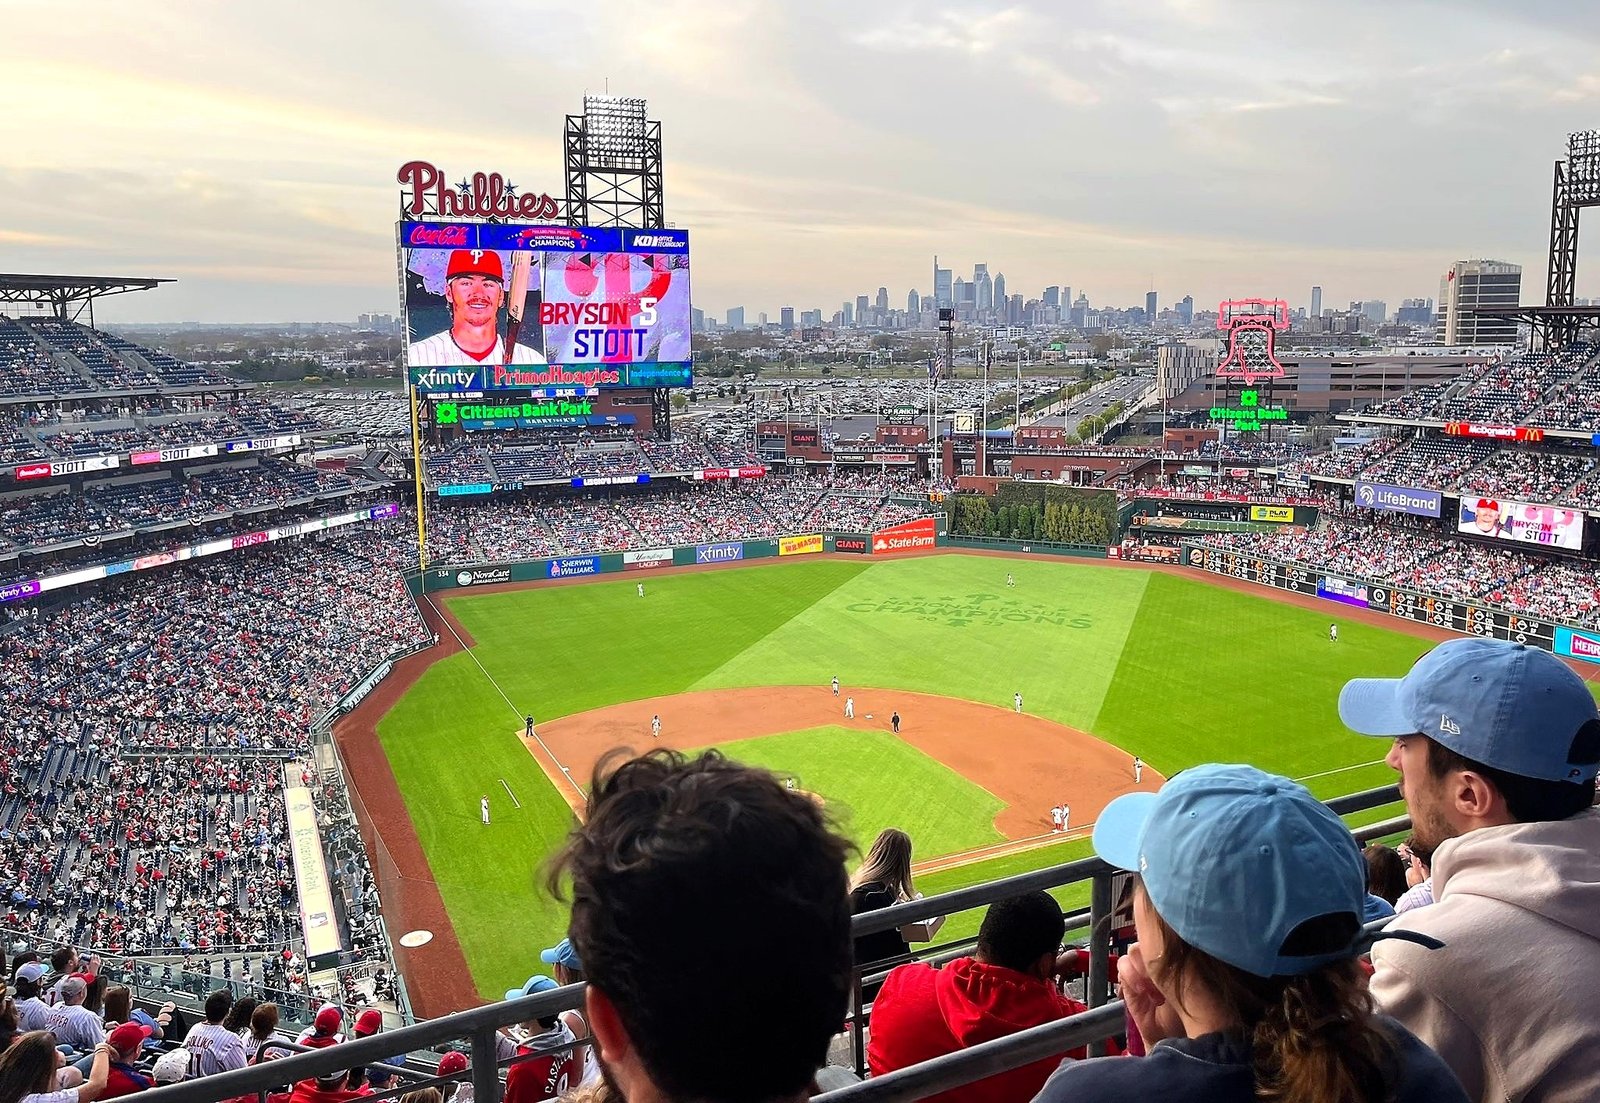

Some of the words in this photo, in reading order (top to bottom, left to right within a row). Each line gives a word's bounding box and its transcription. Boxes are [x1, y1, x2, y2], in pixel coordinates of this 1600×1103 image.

[397, 160, 559, 220] Phillies
[410, 225, 469, 245] Coca-Cola
[633, 235, 658, 247] KDI
[529, 239, 576, 249] CHAMPIONS
[539, 302, 629, 325] BRYSON
[639, 297, 657, 326] 5
[573, 329, 648, 357] STOTT
[417, 368, 476, 388] xfinity
[494, 364, 620, 386] PrimoHoagies
[631, 369, 682, 379] Independence
[460, 405, 520, 420] Citizens
[522, 402, 560, 418] Bank
[560, 402, 592, 416] Park
[1210, 408, 1256, 419] Citizens
[1257, 407, 1288, 419] Bank
[1234, 419, 1260, 431] Park
[1468, 425, 1516, 437] McDonald's
[253, 438, 278, 449] STOTT
[161, 449, 190, 461] STOTT
[53, 461, 87, 474] STOTT
[740, 468, 763, 476] TOYOTA
[612, 475, 638, 484] BAKERY
[440, 485, 489, 494] DENTISTRY
[504, 482, 523, 491] LIFE
[1378, 491, 1436, 510] LifeBrand
[1510, 519, 1552, 531] BRYSON
[232, 532, 269, 549] BRYSON
[798, 537, 821, 548] MASON
[1525, 530, 1560, 544] STOTT
[835, 540, 865, 549] GIANT
[699, 545, 740, 562] xfinity
[561, 558, 594, 568] SHERWIN
[472, 569, 510, 580] NovaCare
[883, 600, 981, 611] NATIONAL
[990, 607, 1071, 617] LEAGUE
[846, 602, 1093, 629] CHAMPIONS
